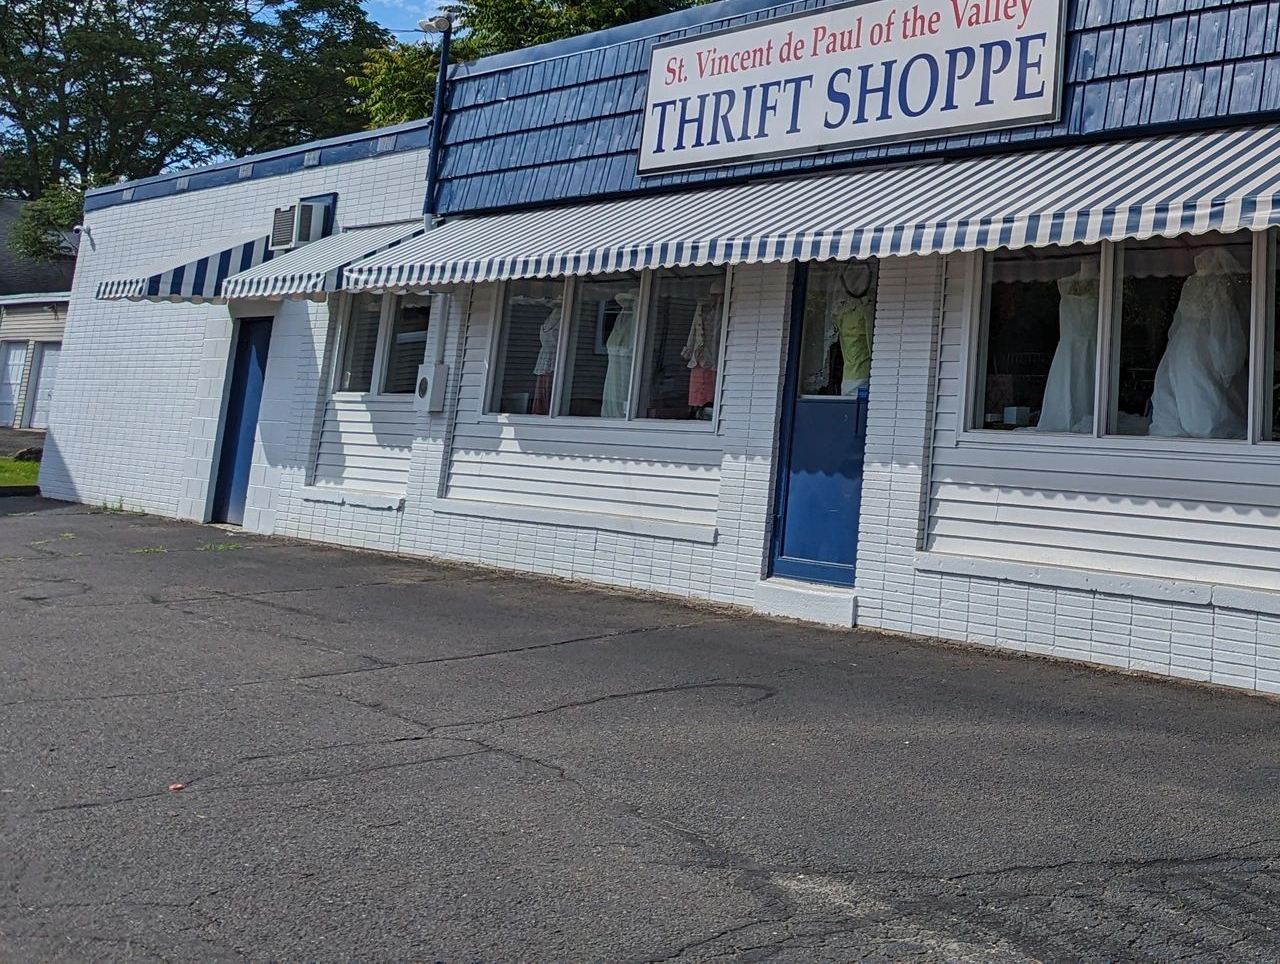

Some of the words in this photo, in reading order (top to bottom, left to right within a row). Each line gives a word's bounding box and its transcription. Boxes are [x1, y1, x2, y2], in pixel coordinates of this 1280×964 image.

[652, 74, 814, 155] THRIFT
[824, 32, 1047, 130] SHOPPE
[664, 56, 688, 86] St.
[696, 38, 774, 79] Vincent
[778, 31, 805, 64] de
[810, 16, 863, 58] Paul
[869, 8, 897, 47] of
[902, 4, 941, 40] the
